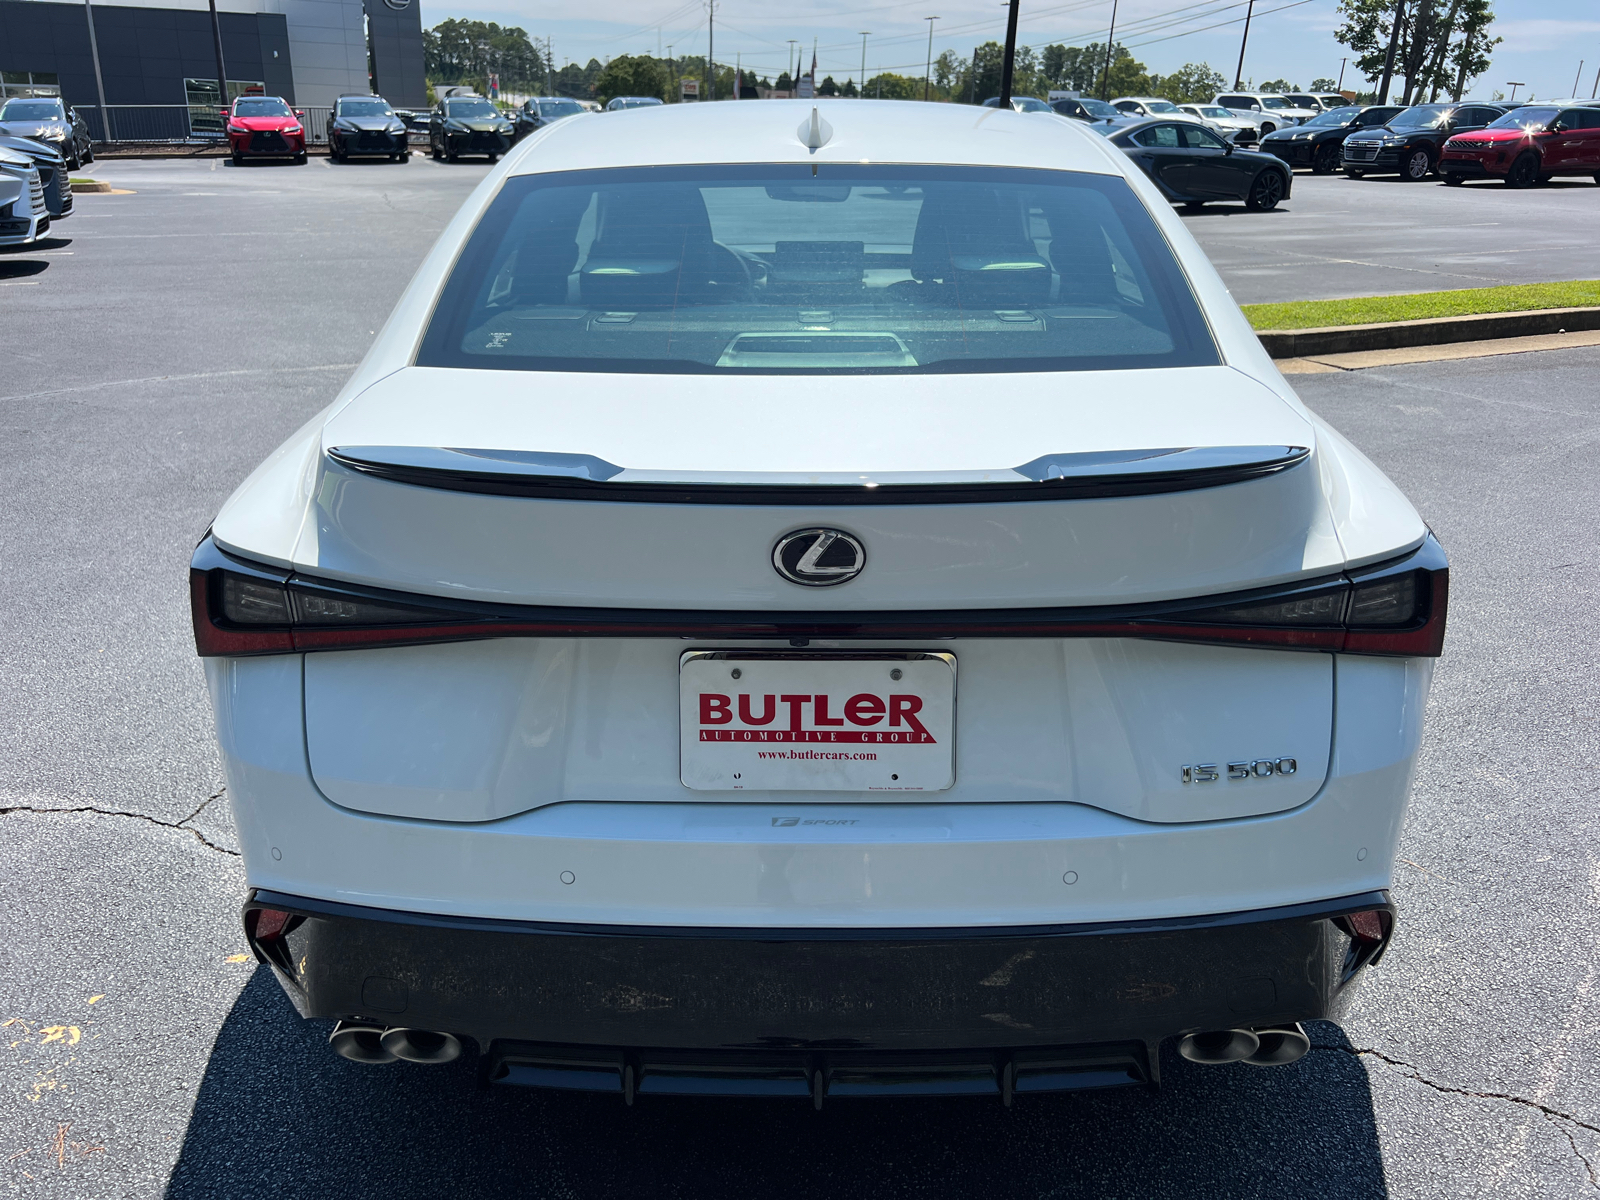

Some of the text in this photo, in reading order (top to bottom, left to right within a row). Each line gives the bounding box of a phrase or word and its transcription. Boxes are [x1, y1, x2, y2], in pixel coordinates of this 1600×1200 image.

[700, 731, 928, 742] AUTOMOTIVE GROUP
[758, 750, 877, 761] www.butlercars.com
[1181, 756, 1297, 783] IS 500
